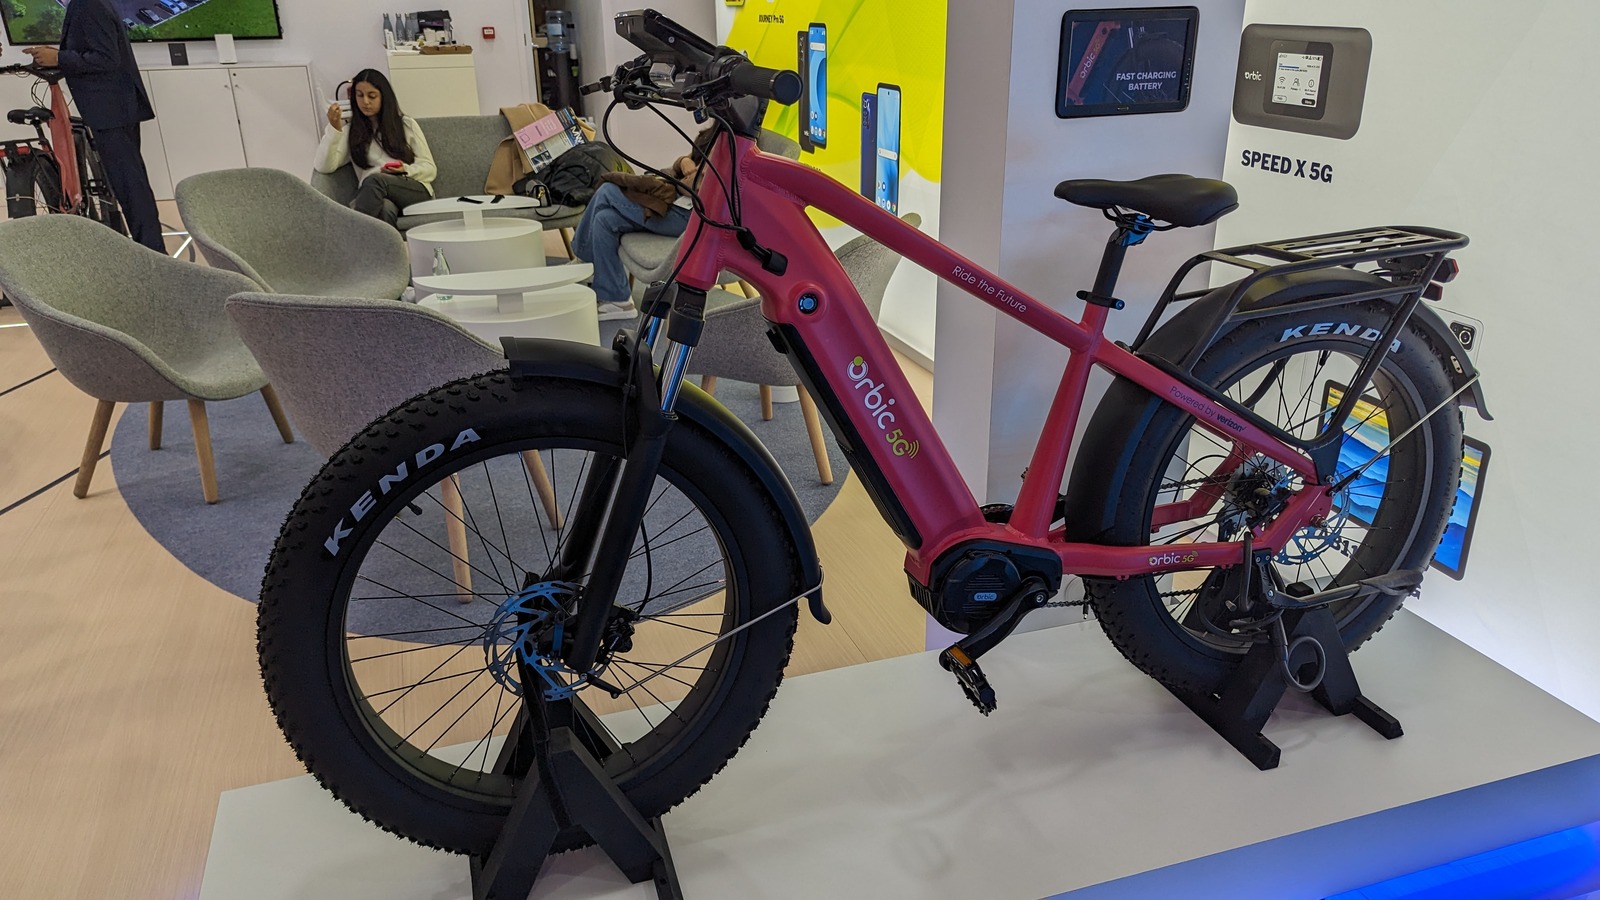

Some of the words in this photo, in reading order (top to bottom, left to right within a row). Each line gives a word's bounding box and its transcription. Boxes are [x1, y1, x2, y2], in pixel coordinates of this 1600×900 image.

[758, 14, 773, 23] JOURNEY
[1116, 72, 1136, 81] FAST
[1136, 71, 1177, 80] CHARGING
[1128, 82, 1163, 91] BATTERY
[1241, 149, 1292, 175] SPEED
[1294, 159, 1307, 178] X
[1309, 162, 1333, 183] 5G
[952, 265, 977, 284] Ride
[977, 279, 995, 295] the
[995, 289, 1027, 313] Future
[1169, 386, 1206, 411] Powered
[1205, 405, 1216, 417] by
[1216, 413, 1244, 432] verizon
[885, 428, 910, 456] 5G
[324, 428, 481, 557] KENDA
[1181, 554, 1195, 563] 5G
